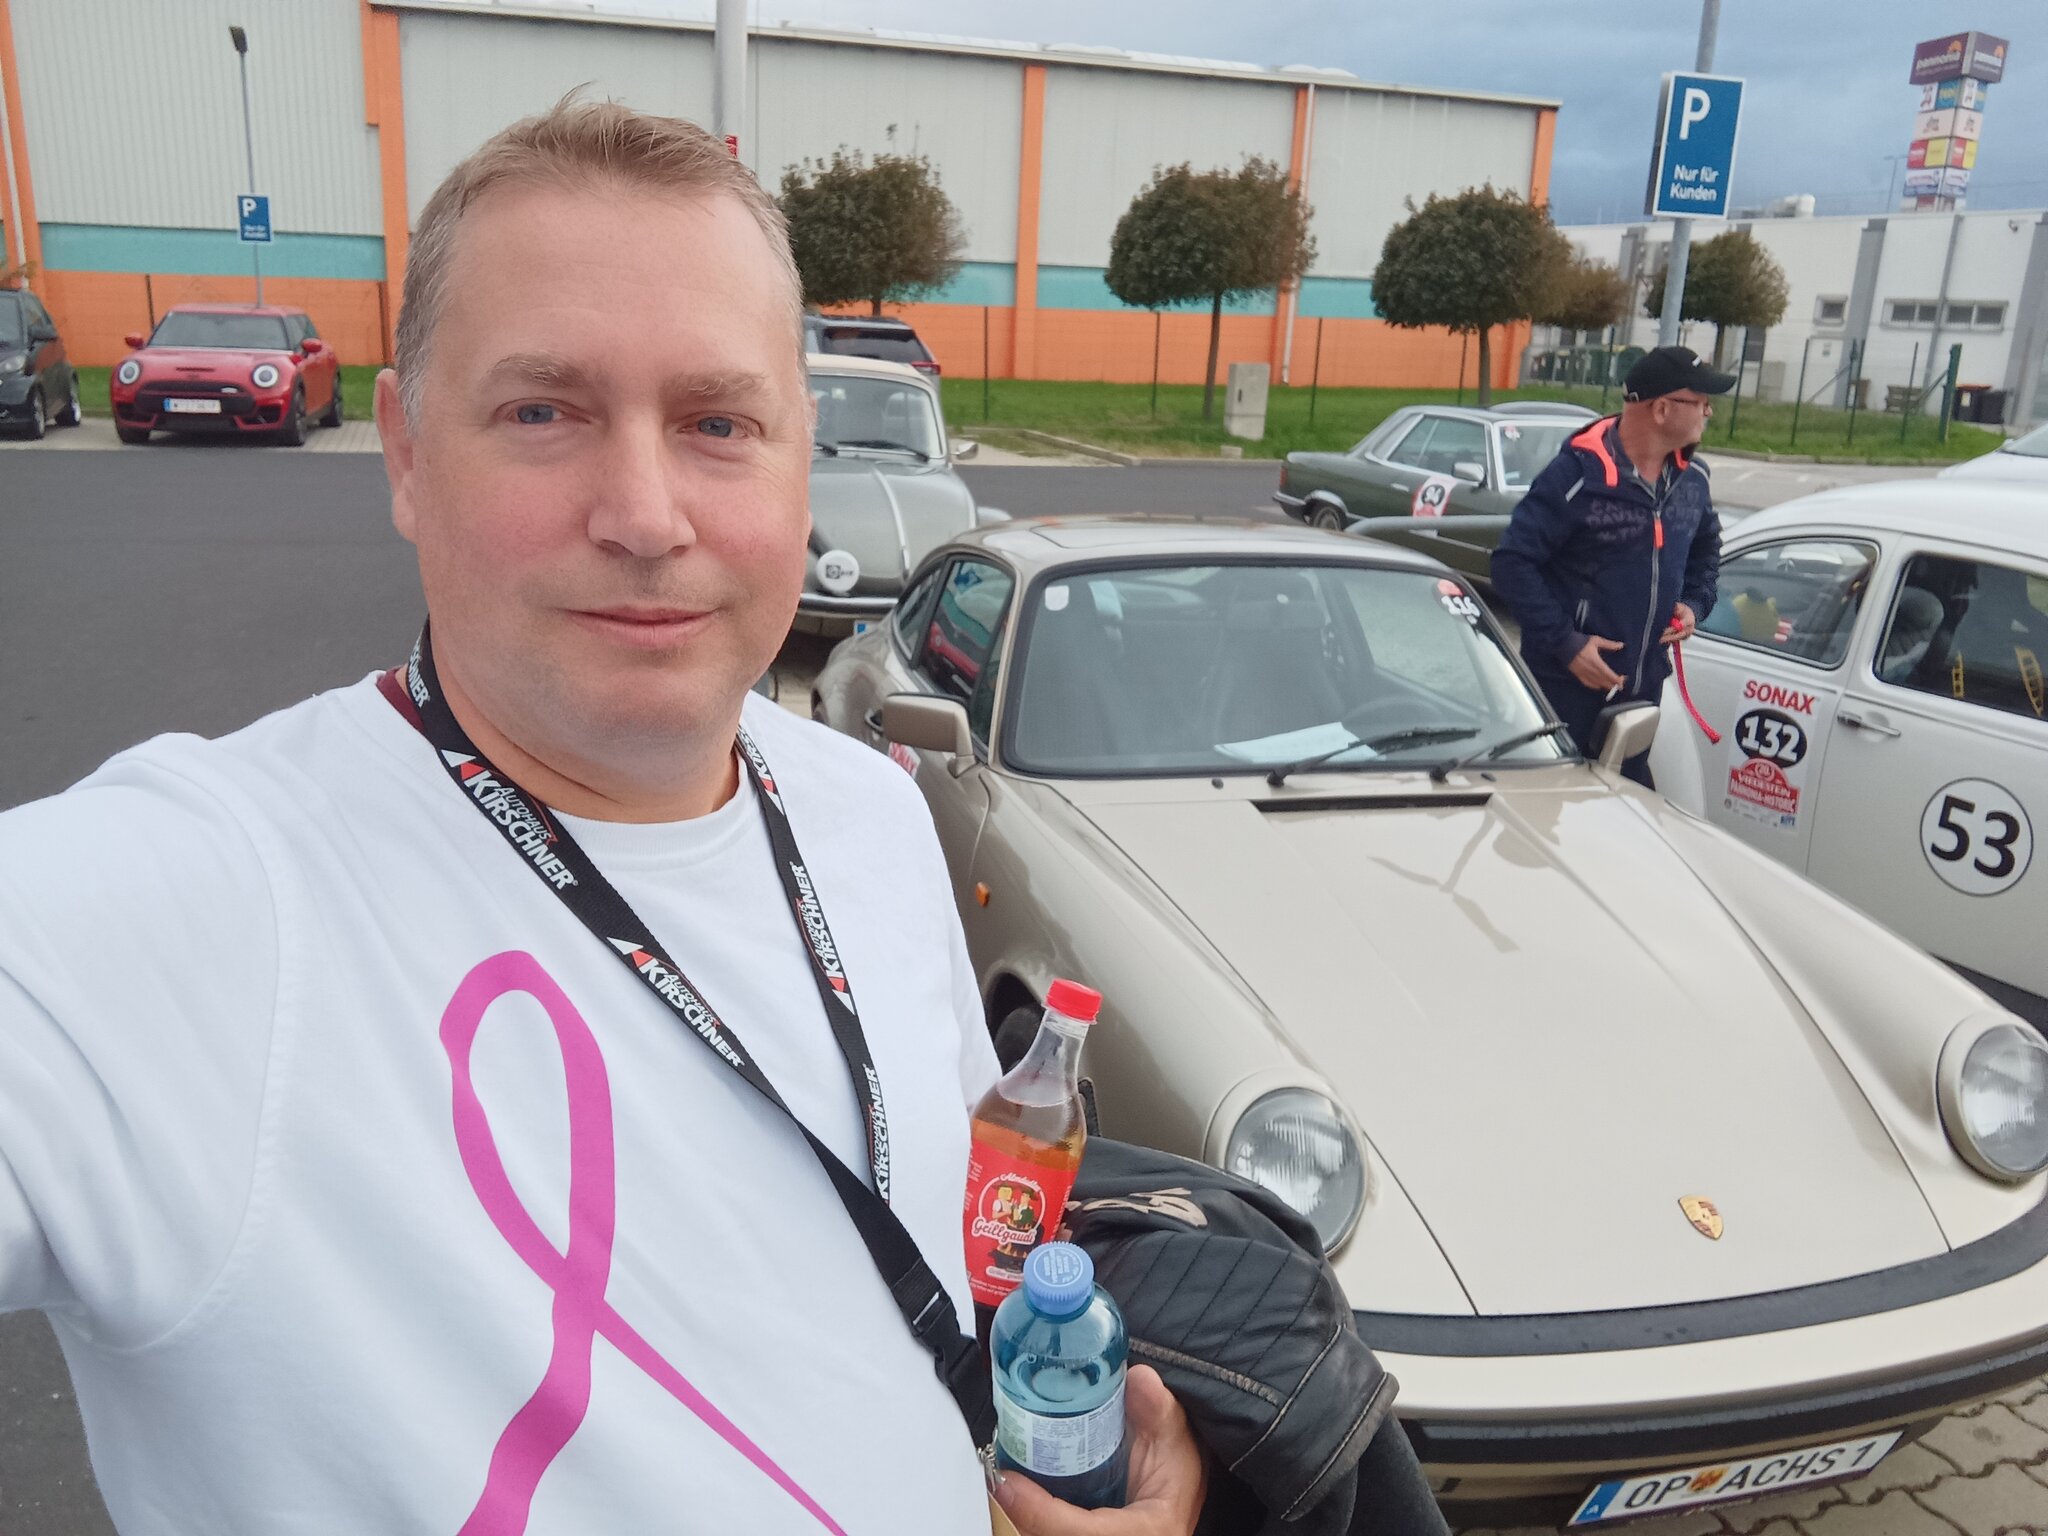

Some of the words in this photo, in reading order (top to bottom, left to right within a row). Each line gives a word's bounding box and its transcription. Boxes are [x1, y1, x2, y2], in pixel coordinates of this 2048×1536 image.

[1680, 88, 1711, 140] P
[1670, 182, 1717, 201] Kunden
[1674, 164, 1699, 182] Nur
[1700, 165, 1719, 183] für
[242, 198, 257, 218] P
[1743, 679, 1815, 715] SONAX
[1741, 715, 1800, 763] 132
[464, 770, 574, 890] KIRSCHNER
[495, 786, 552, 839] AUTOHAUS
[1930, 794, 2020, 878] 53
[792, 864, 844, 978] KIRSCHNER
[638, 957, 743, 1067] KIRSCHNER
[663, 974, 717, 1023] AUTOHAUS
[864, 1066, 889, 1200] KIRSCHNER
[1624, 1475, 1692, 1509] OP
[1715, 1447, 1846, 1494] ACHS
[1851, 1441, 1878, 1468] 1
